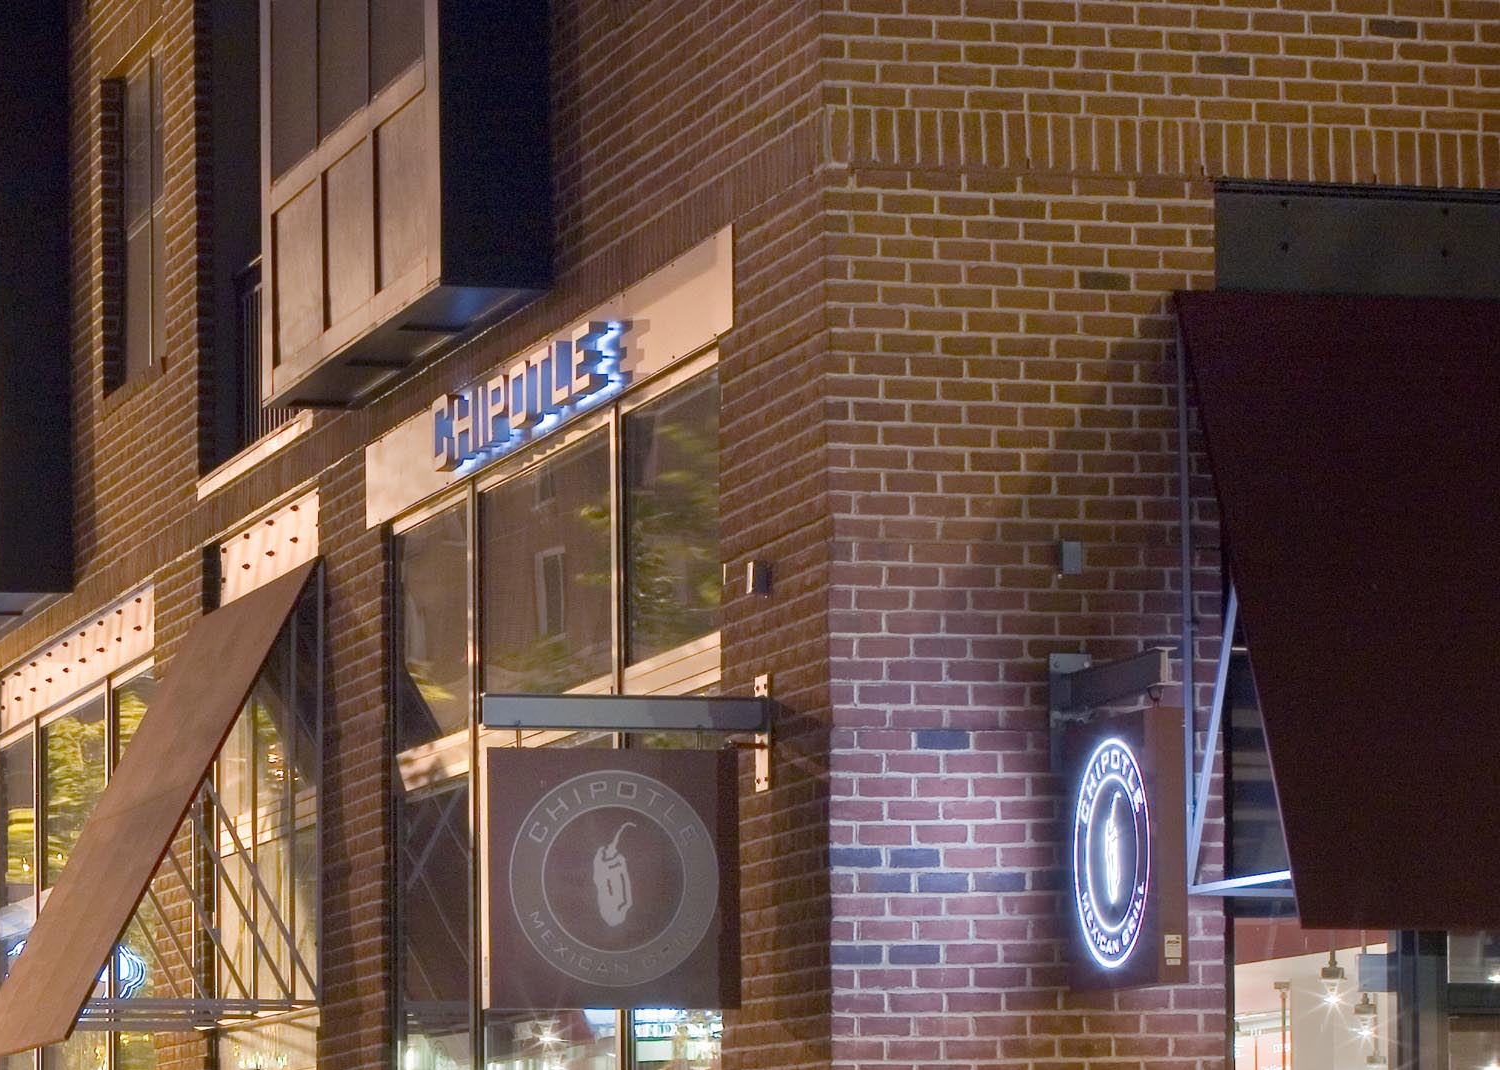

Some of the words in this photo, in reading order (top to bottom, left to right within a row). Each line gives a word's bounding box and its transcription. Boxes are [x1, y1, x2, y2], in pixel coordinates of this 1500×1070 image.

[431, 320, 608, 473] CHIPOTLE
[528, 781, 699, 847] CHIPOTLE
[1081, 749, 1143, 824] CHIPOTLE
[526, 911, 630, 975] MEXICAN
[1082, 892, 1120, 954] MEXICAN
